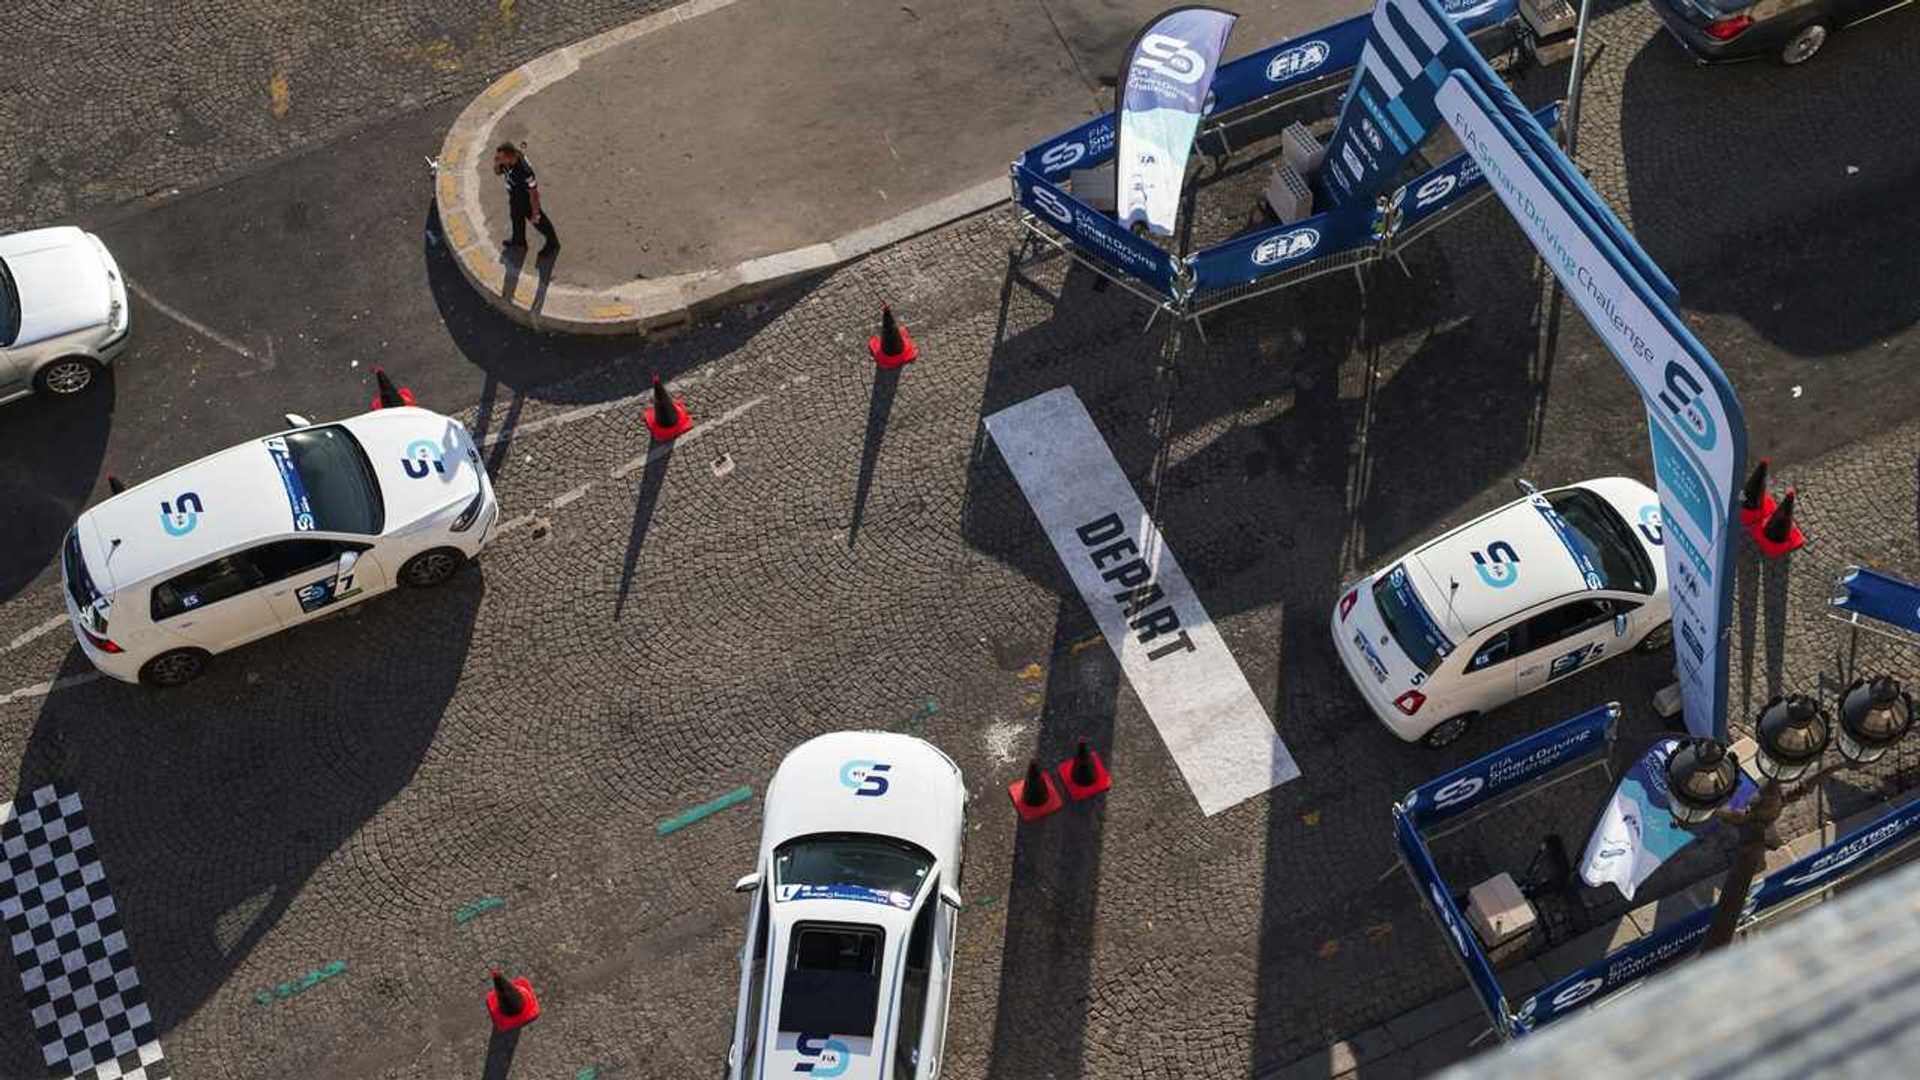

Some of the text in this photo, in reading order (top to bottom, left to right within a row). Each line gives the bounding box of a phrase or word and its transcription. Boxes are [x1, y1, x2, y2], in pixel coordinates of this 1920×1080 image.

[1270, 46, 1326, 80] FIA
[1255, 232, 1315, 263] FIA
[1075, 512, 1197, 662] DEPART
[1410, 672, 1425, 686] 5
